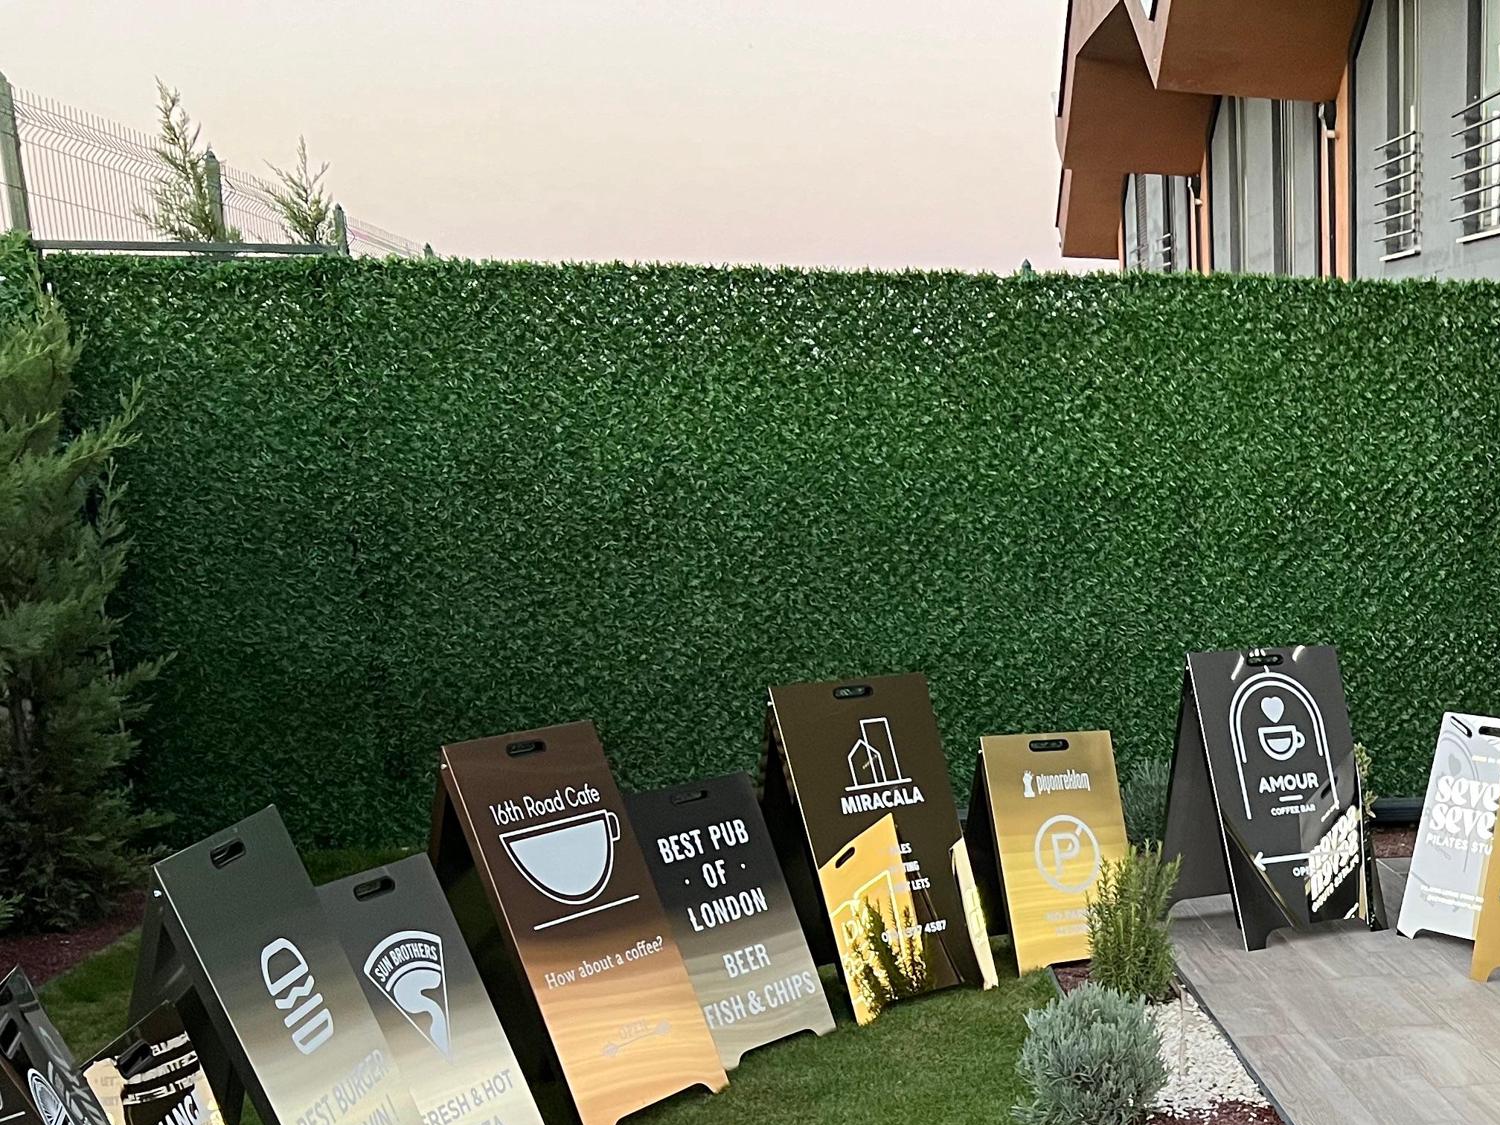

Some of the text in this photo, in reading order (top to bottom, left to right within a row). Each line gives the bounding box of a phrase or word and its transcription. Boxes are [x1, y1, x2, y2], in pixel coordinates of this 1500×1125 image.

[840, 786, 925, 815] MIRACALA
[1258, 772, 1319, 794] AMOUR
[489, 783, 601, 826] 16th Road Cafe
[1270, 804, 1316, 817] COFFEE BAR
[657, 818, 750, 864] BEST PUB
[1425, 832, 1493, 856] PILATES STU
[701, 859, 728, 889] OF
[912, 877, 931, 891] LETS
[687, 887, 769, 932] LONDON
[374, 942, 438, 983] SUN BROTHERS
[544, 935, 664, 990] How about a coffee?
[722, 943, 771, 979] BEER
[703, 971, 817, 1030] FISH & CHIPS
[332, 1048, 391, 1115] BURGER
[470, 1087, 484, 1107] &
[479, 1069, 514, 1101] HOT
